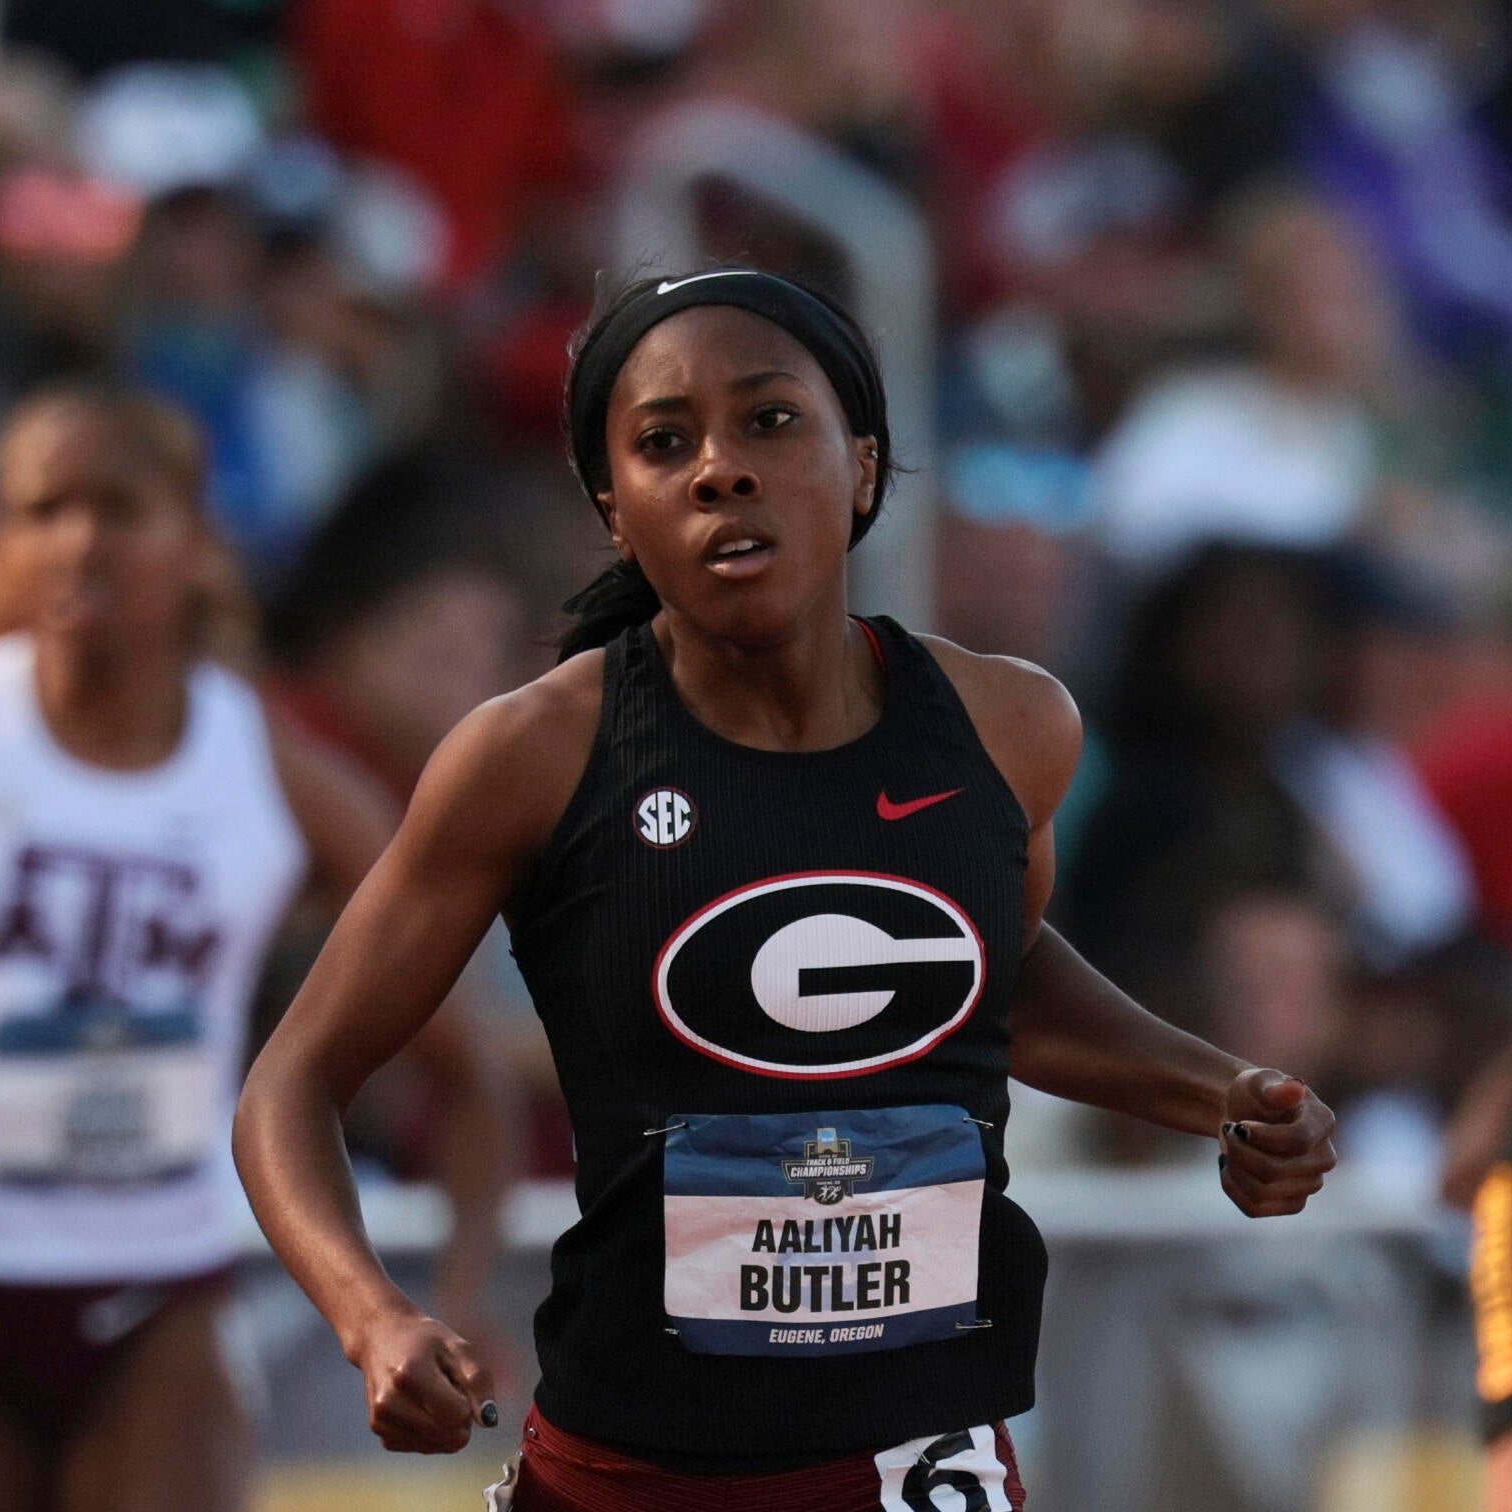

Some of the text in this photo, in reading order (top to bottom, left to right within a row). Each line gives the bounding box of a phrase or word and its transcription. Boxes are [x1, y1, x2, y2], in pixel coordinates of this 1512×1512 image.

[638, 790, 691, 844] SEC
[663, 880, 980, 1070] G
[790, 1164, 867, 1177] CHAMPIONSHIPS
[806, 1158, 826, 1166] TRACK
[752, 1213, 901, 1253] AALIYAH
[740, 1259, 910, 1313] BUTLER
[769, 1323, 885, 1344] EUGENE, OREGON
